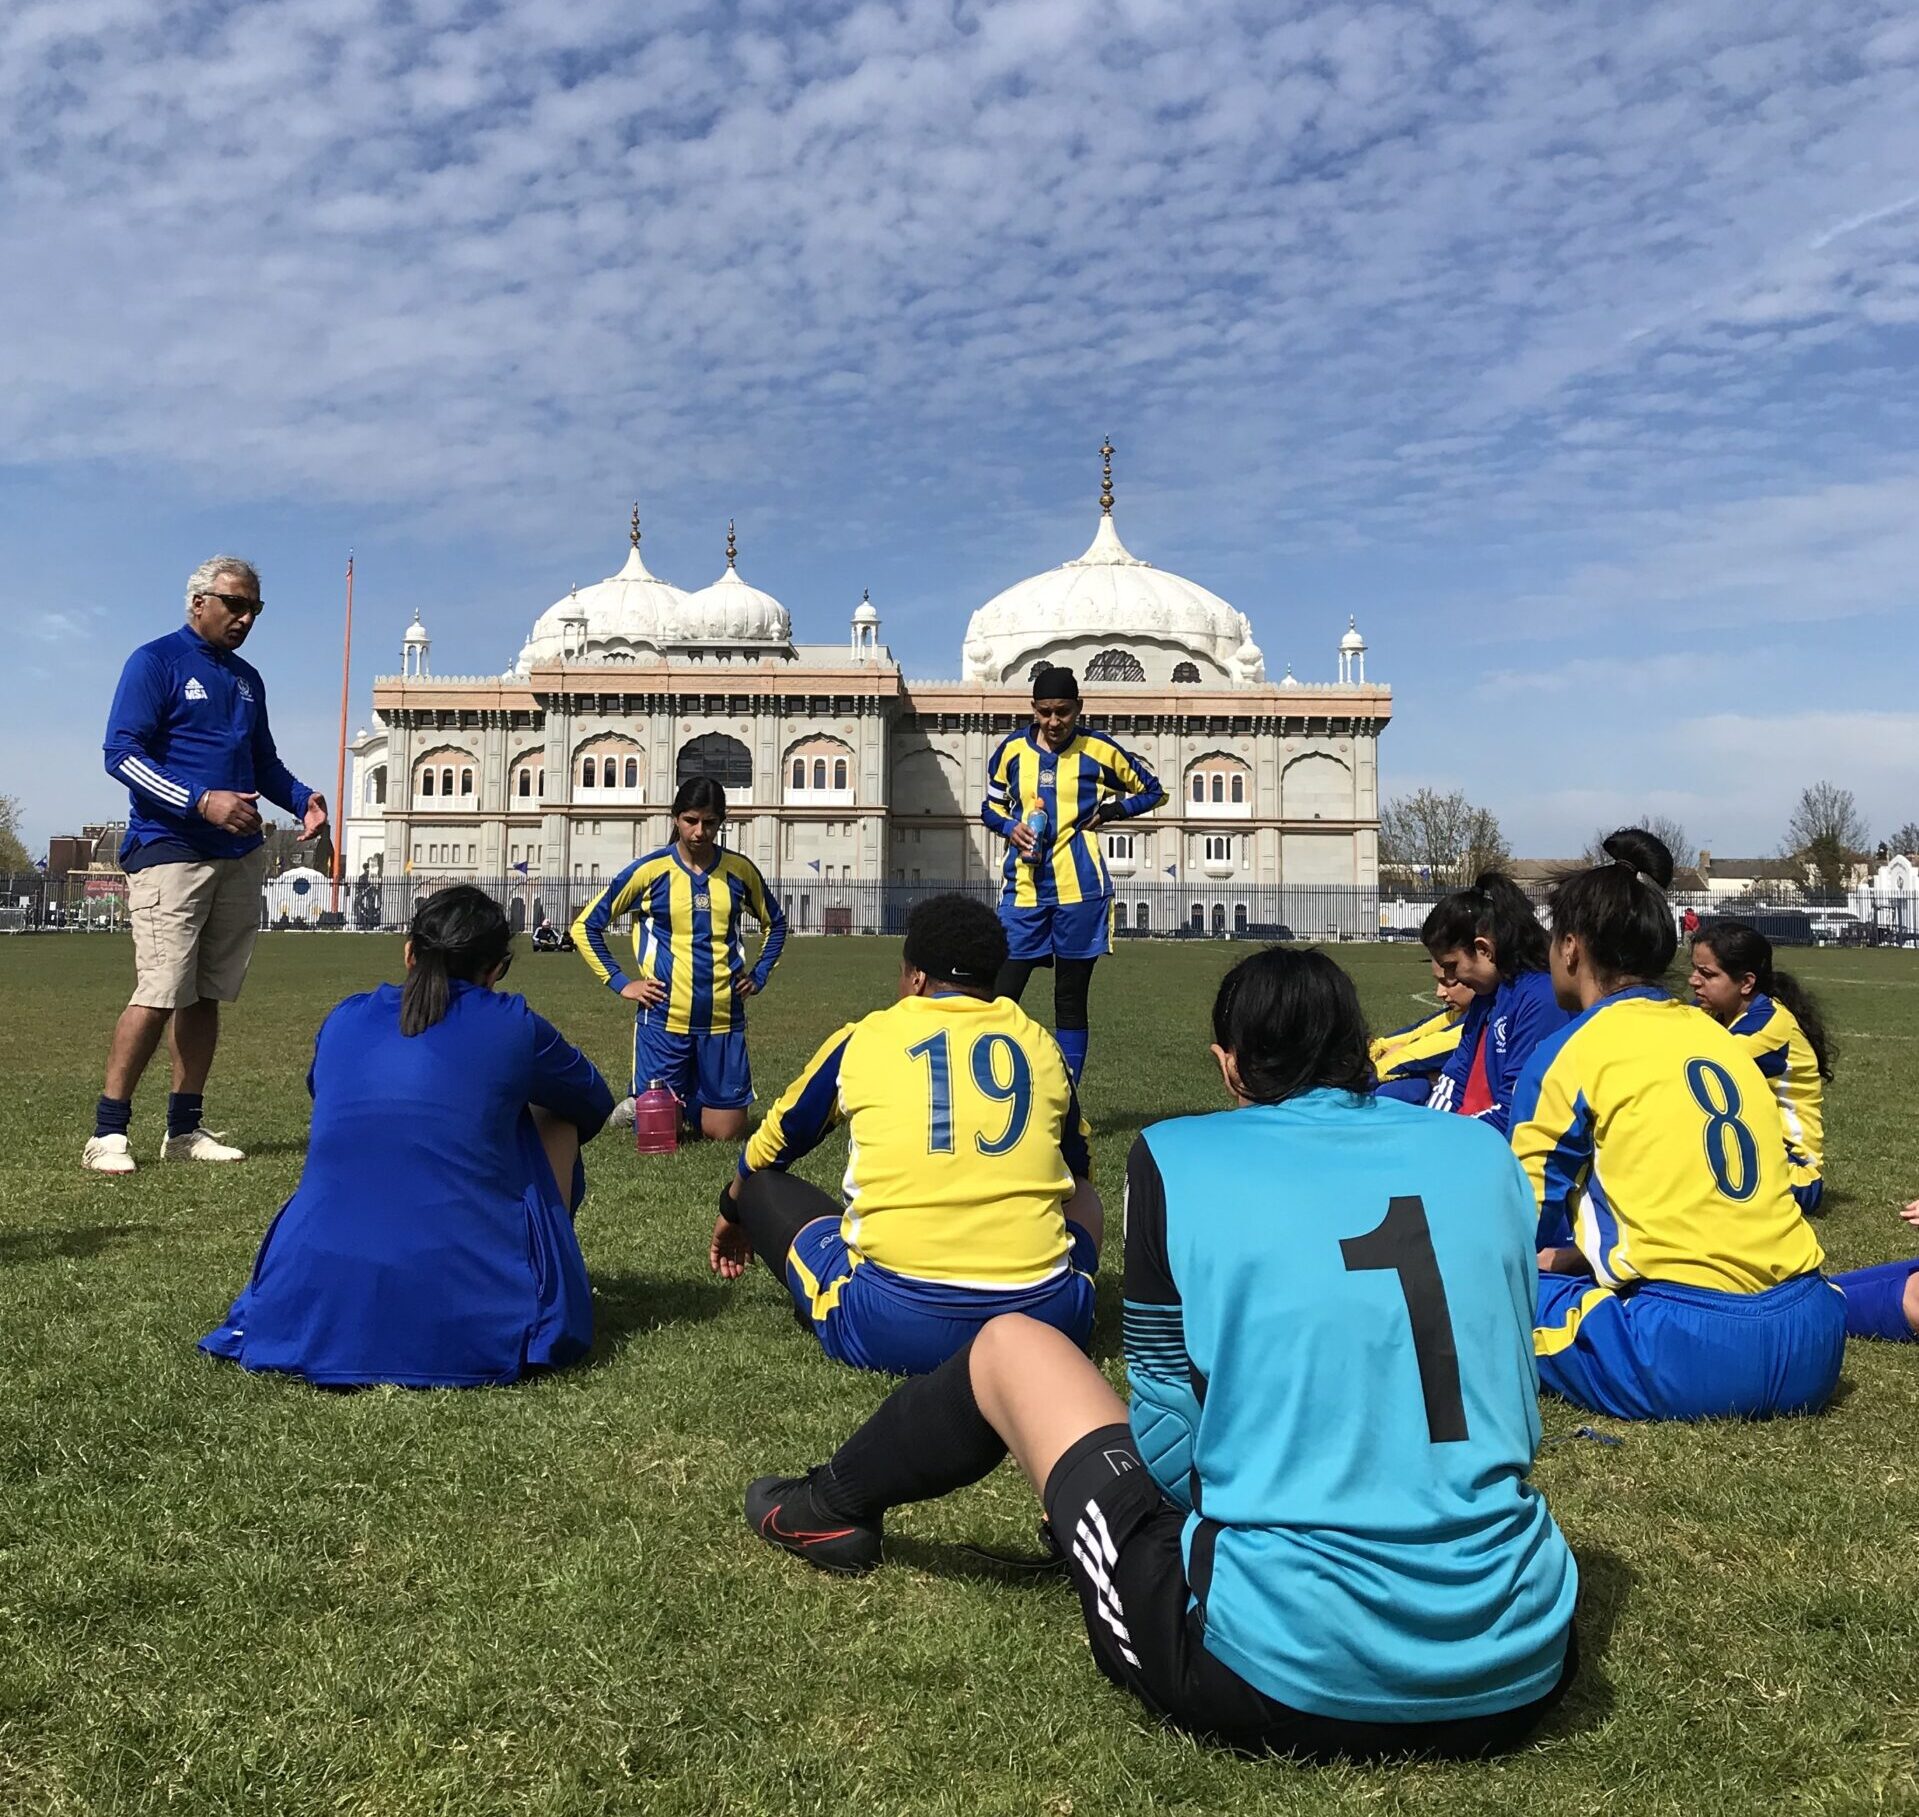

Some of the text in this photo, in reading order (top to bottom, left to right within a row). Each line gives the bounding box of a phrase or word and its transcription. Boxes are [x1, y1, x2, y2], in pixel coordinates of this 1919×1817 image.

[184, 689, 208, 700] MSA
[905, 1027, 1034, 1157] 19
[1683, 1056, 1761, 1202] 8
[1339, 1195, 1469, 1443] 1
